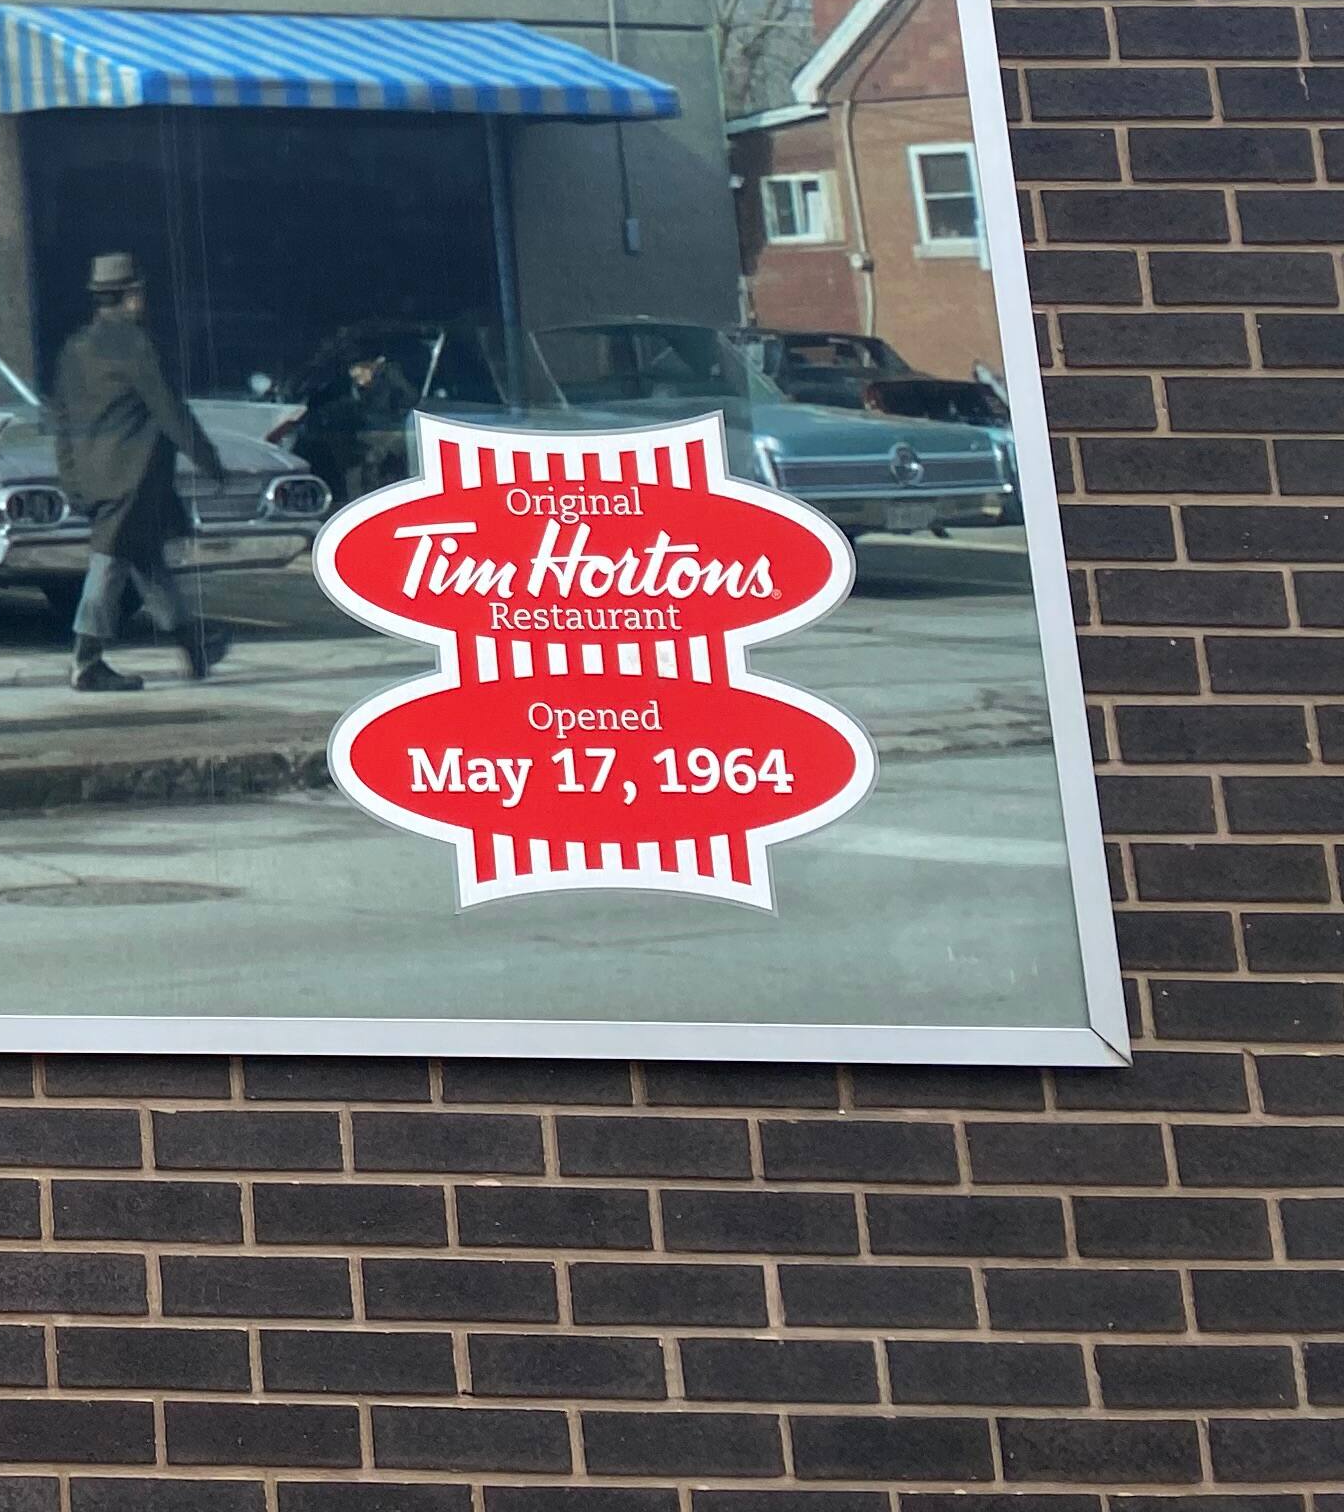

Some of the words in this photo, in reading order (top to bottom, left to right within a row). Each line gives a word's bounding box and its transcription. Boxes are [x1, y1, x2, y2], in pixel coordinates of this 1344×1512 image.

[505, 487, 644, 524] Original
[394, 521, 517, 599] Tim
[527, 518, 773, 599] Hortons
[490, 603, 682, 631] Restaurant
[527, 701, 663, 739] Opened
[407, 747, 533, 807] May
[550, 748, 636, 805] 17,
[654, 748, 795, 794] 1964
